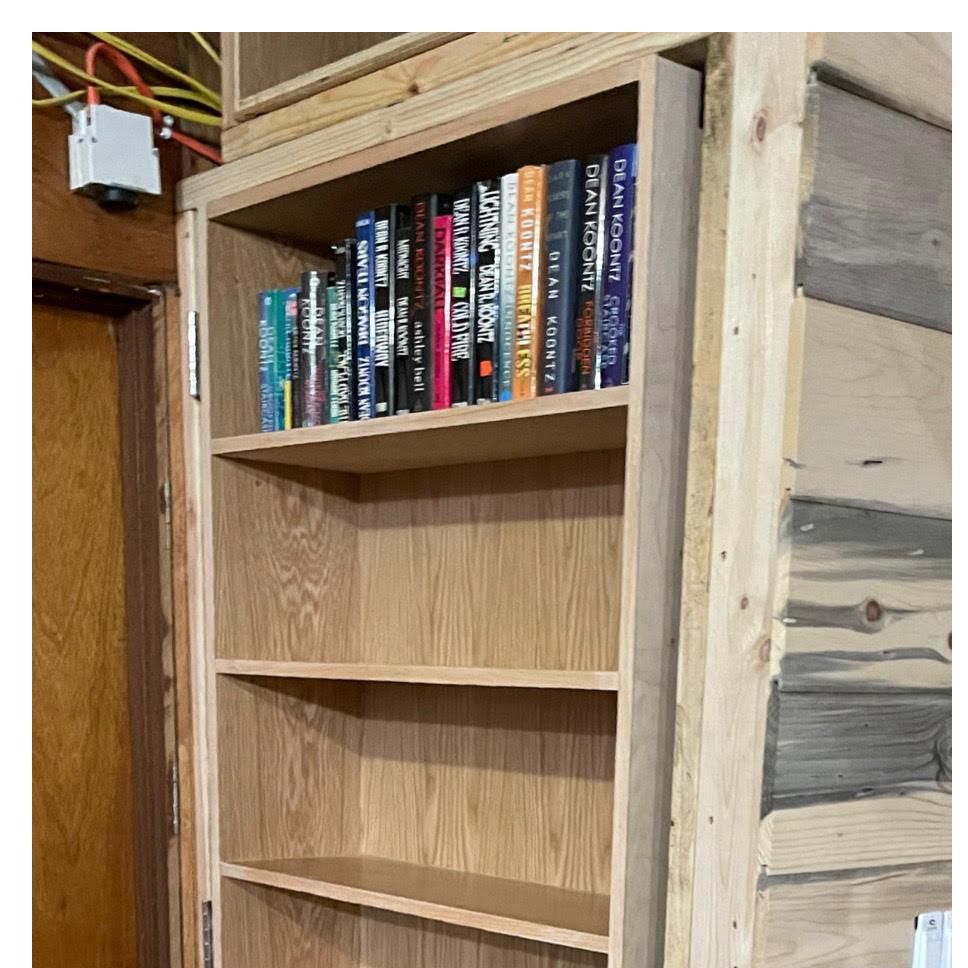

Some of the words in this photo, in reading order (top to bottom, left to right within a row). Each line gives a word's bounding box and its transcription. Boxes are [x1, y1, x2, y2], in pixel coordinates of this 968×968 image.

[585, 164, 600, 216] DEAN
[611, 158, 627, 209] DEAN
[453, 198, 470, 227] DEAN
[478, 183, 500, 253] LIGHTNING
[452, 236, 470, 275] KOONTZ
[520, 207, 535, 271] KOONTZ
[581, 221, 598, 292] KOONTZ
[608, 213, 625, 282] KOONTZ
[434, 227, 447, 310] DARKFALL
[479, 264, 496, 293] DEAN
[548, 251, 560, 299] DEAN
[301, 298, 312, 355] KOONTZ
[315, 306, 325, 346] DEAN
[412, 321, 426, 364] ashley
[451, 302, 470, 333] COLD
[477, 302, 496, 344] KOONTZ
[515, 284, 532, 378] BREATHLESS
[544, 315, 558, 383] KOONTZ
[414, 367, 425, 392] bell
